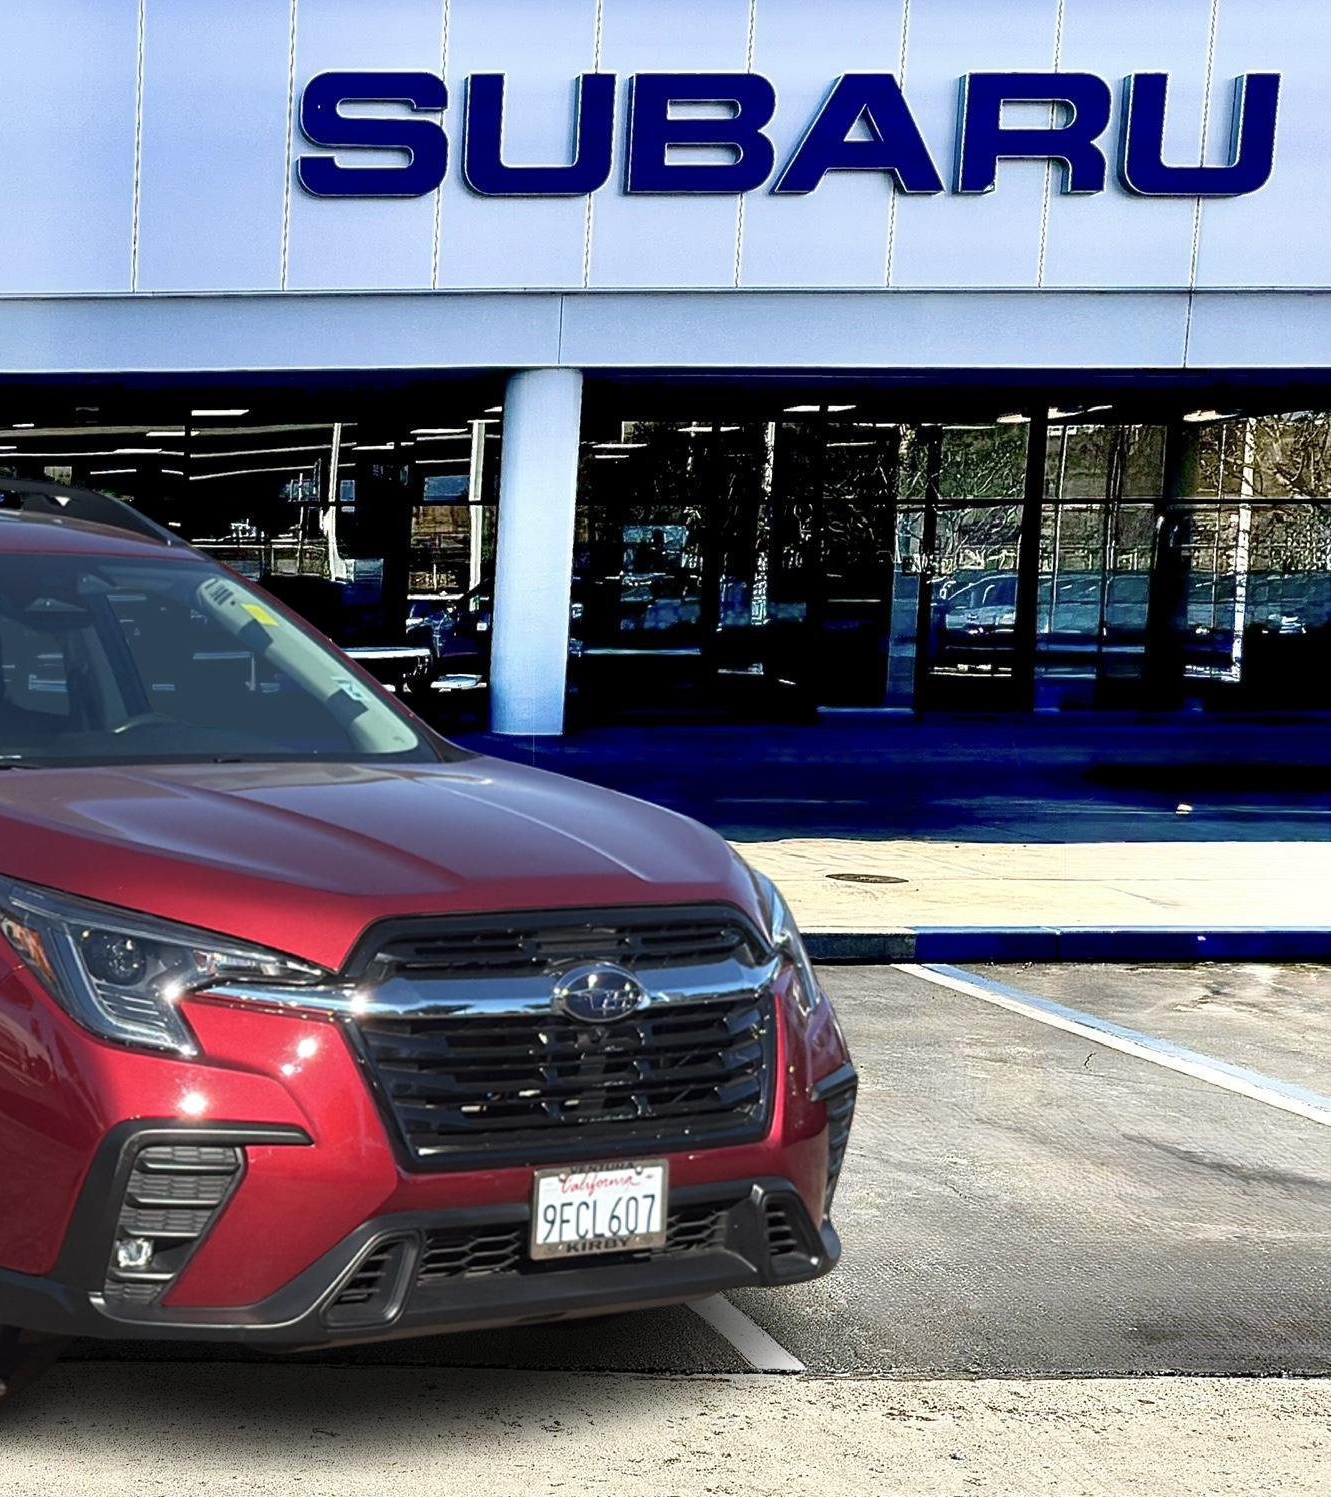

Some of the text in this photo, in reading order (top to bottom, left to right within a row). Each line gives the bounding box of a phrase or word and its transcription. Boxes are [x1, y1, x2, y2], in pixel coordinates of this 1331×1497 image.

[296, 72, 1280, 199] SUBARU
[570, 1161, 635, 1175] VENTURA
[561, 1175, 640, 1197] California
[542, 1193, 656, 1243] 9FCL607
[565, 1236, 631, 1253] KIRBY
